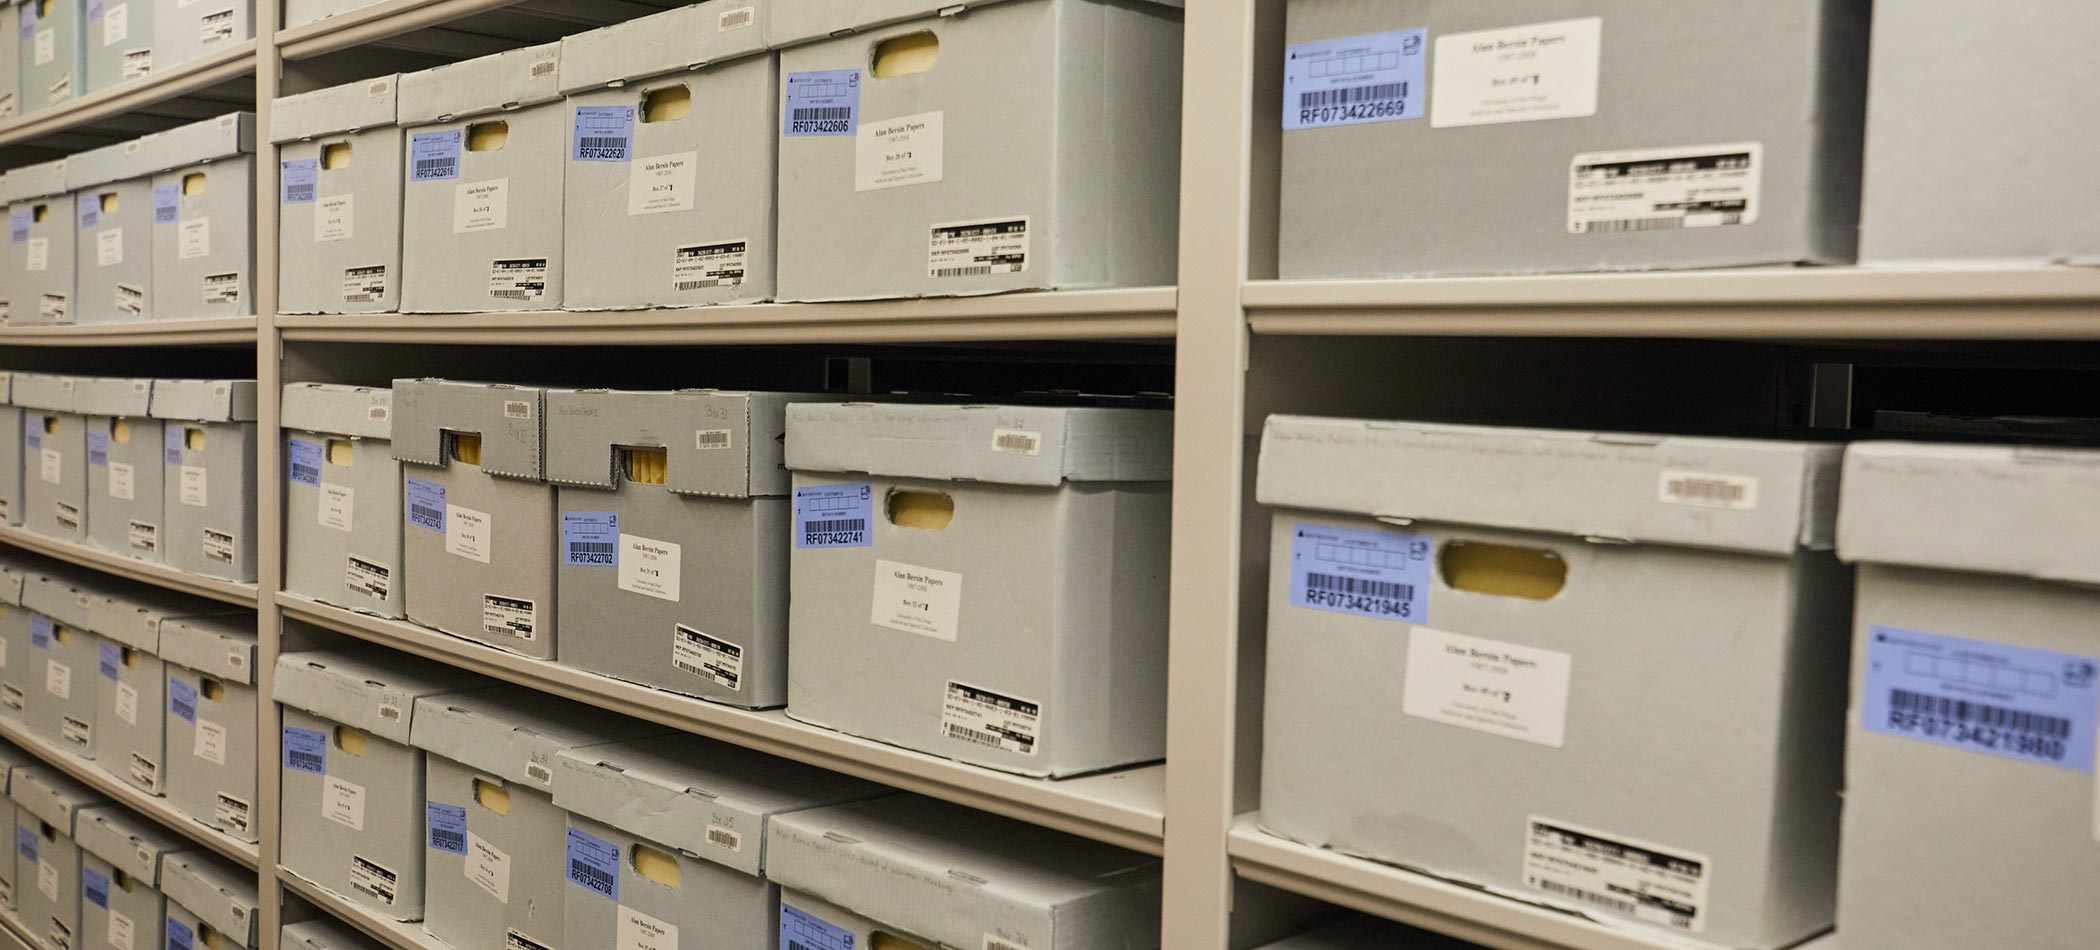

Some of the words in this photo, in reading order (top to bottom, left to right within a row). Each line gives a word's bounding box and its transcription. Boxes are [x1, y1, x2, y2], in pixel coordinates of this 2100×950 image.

[1300, 100, 1405, 125] RF073422669
[792, 120, 849, 133] RF073422606
[874, 129, 887, 138] Alan
[888, 126, 906, 136] Bersin
[906, 123, 925, 134] Papers
[580, 148, 625, 159] RF073422620
[656, 162, 669, 170] Bersin
[669, 160, 684, 169] Papers
[806, 531, 863, 545] RF073422741
[642, 545, 654, 553] Bersin
[654, 547, 668, 556] Papers
[570, 552, 613, 564] RF073422702
[894, 570, 906, 580] Alan
[906, 573, 923, 584] Bersin
[924, 576, 943, 587] Papers
[1306, 588, 1410, 618] RF073421945
[572, 869, 612, 896] RF073422708
[652, 924, 666, 936] Papers
